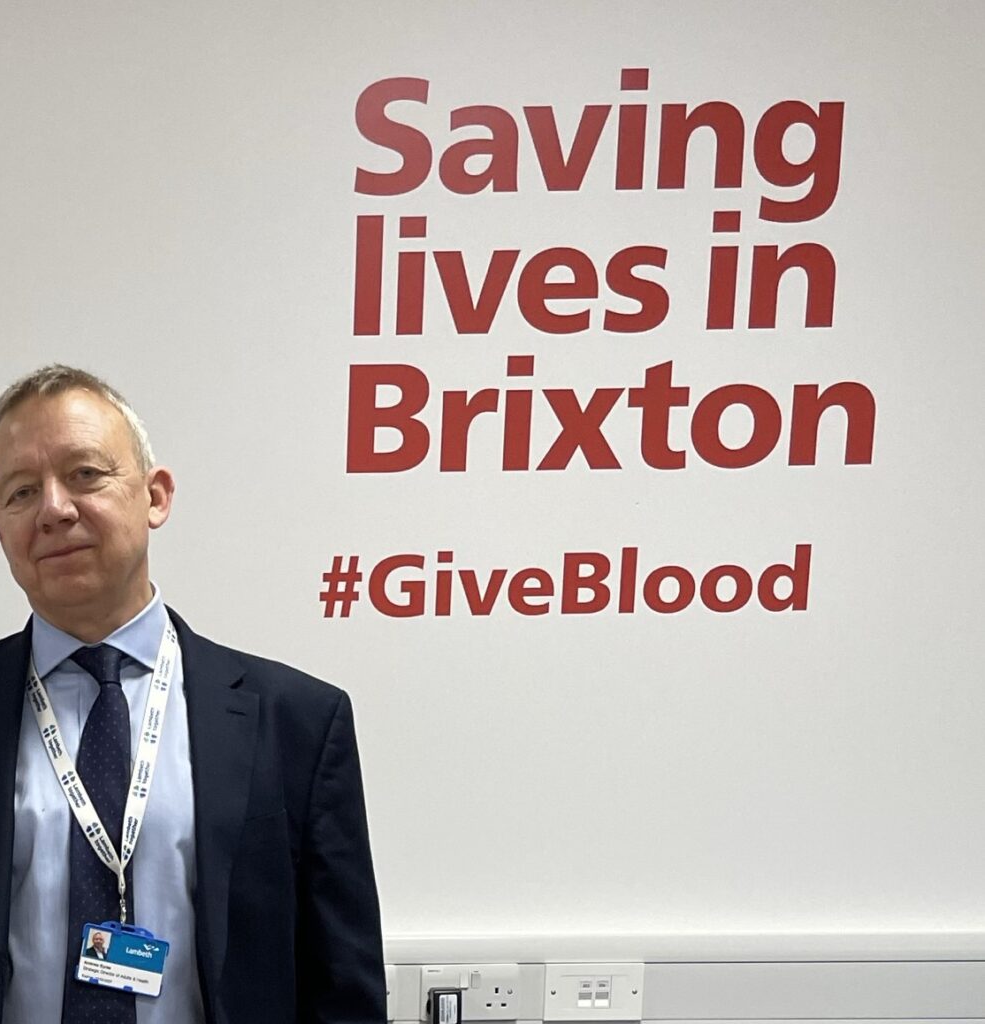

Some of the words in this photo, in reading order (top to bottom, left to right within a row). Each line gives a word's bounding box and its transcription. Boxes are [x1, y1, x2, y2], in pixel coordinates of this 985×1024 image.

[355, 68, 846, 223] Saving
[354, 215, 671, 337] lives
[707, 210, 837, 330] in
[346, 355, 874, 474] Brixton
[320, 543, 812, 619] #GiveBlood
[125, 946, 152, 958] Lambeth
